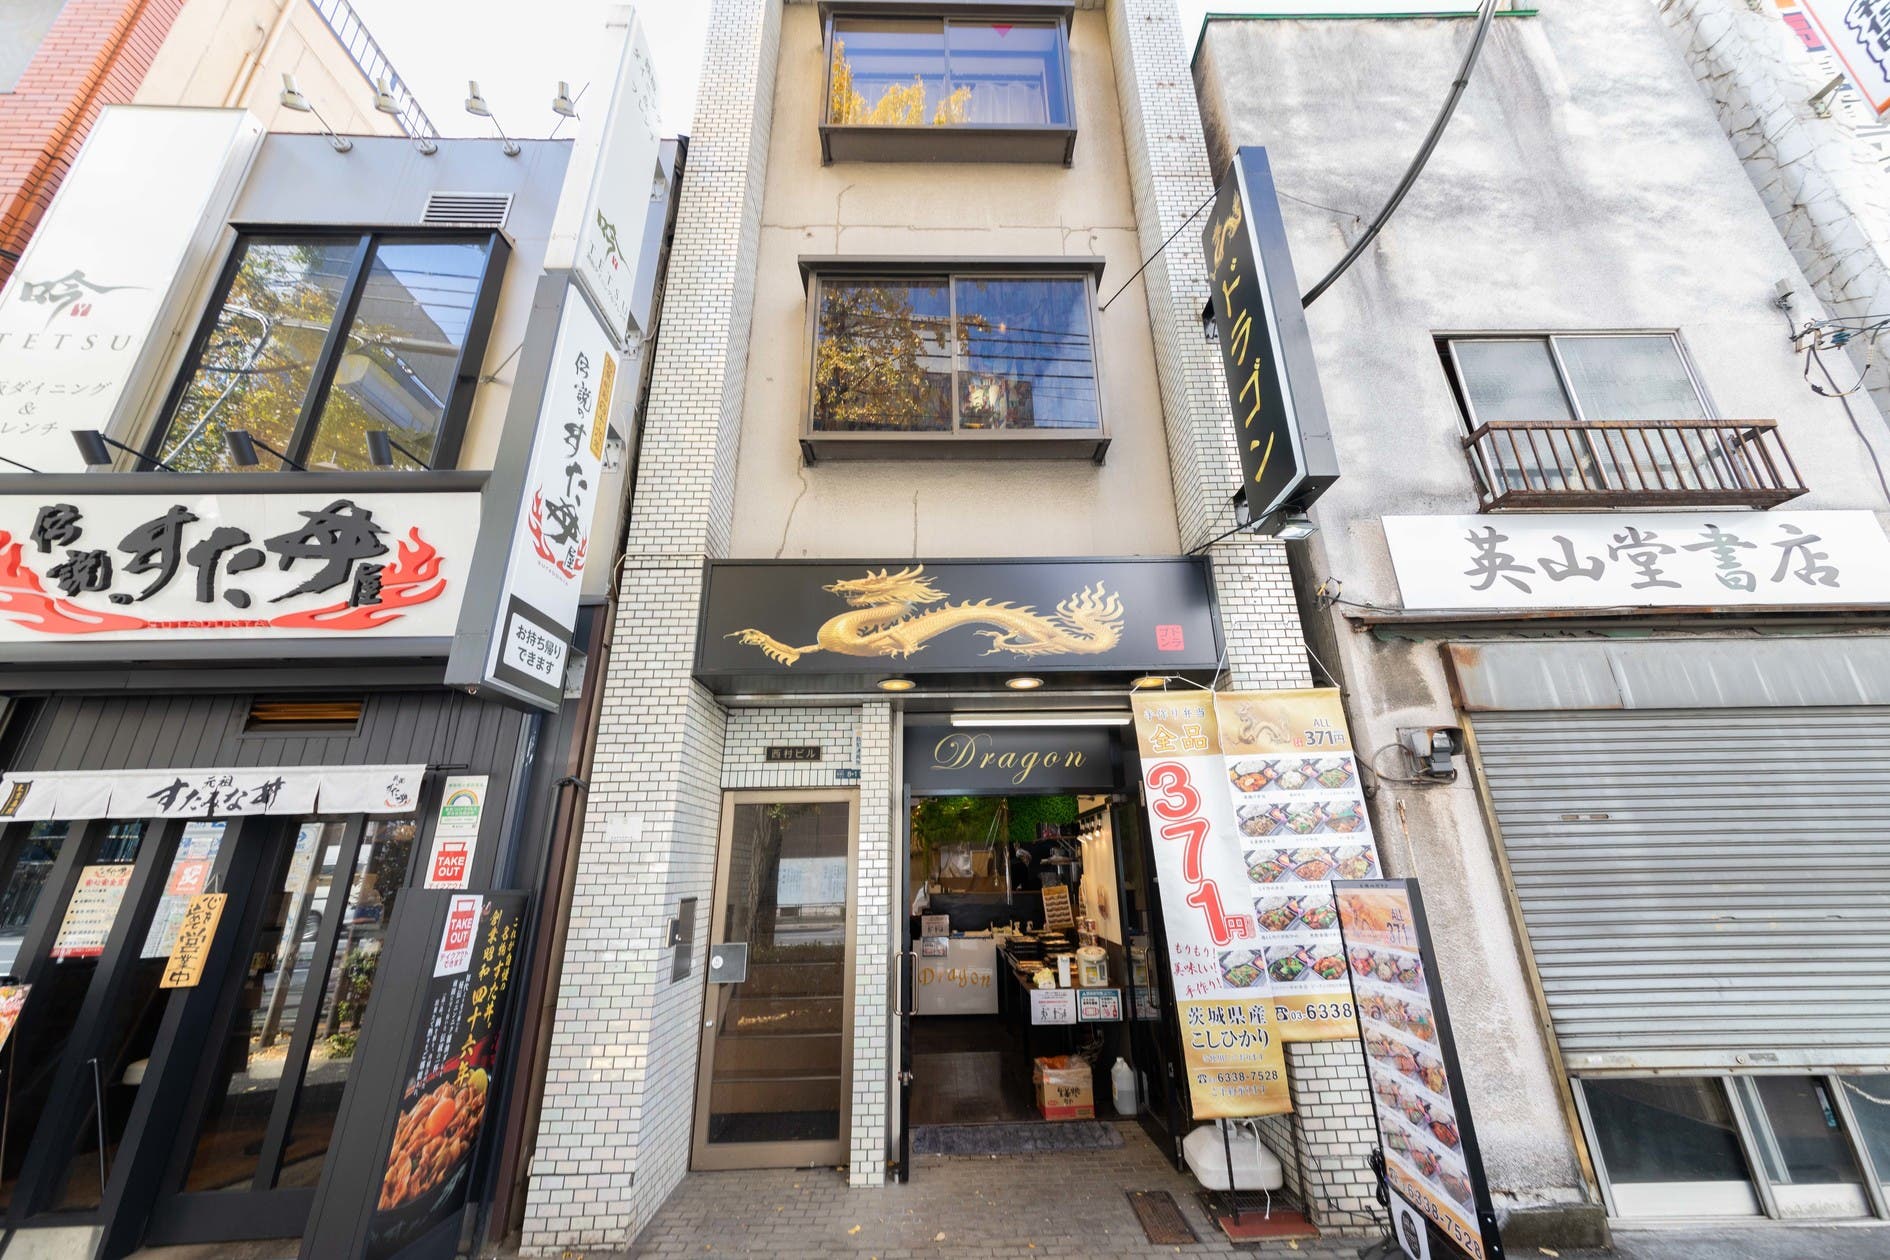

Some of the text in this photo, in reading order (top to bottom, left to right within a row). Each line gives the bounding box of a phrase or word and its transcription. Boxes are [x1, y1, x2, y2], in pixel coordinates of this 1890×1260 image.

[1221, 257, 1275, 482] ドラゴン
[18, 401, 37, 415] &
[1463, 523, 1841, 594] 英山堂書店
[515, 624, 562, 660] お持ち帰り
[517, 646, 555, 675] できます
[1313, 718, 1331, 728] ALL
[1150, 724, 1208, 752] 全品
[1304, 730, 1345, 746] 371円
[930, 733, 1087, 785] Dragon
[202, 776, 234, 790] 元祖
[438, 856, 465, 867] TAKE
[438, 867, 461, 877] OUT
[450, 918, 473, 930] TAKE
[450, 931, 469, 944] OUT
[1188, 1004, 1267, 1026] 茨城県産
[1290, 1003, 1353, 1021] 03-6338
[1191, 1028, 1270, 1049] こしひかり
[1407, 1183, 1483, 1260] 6338-7528
